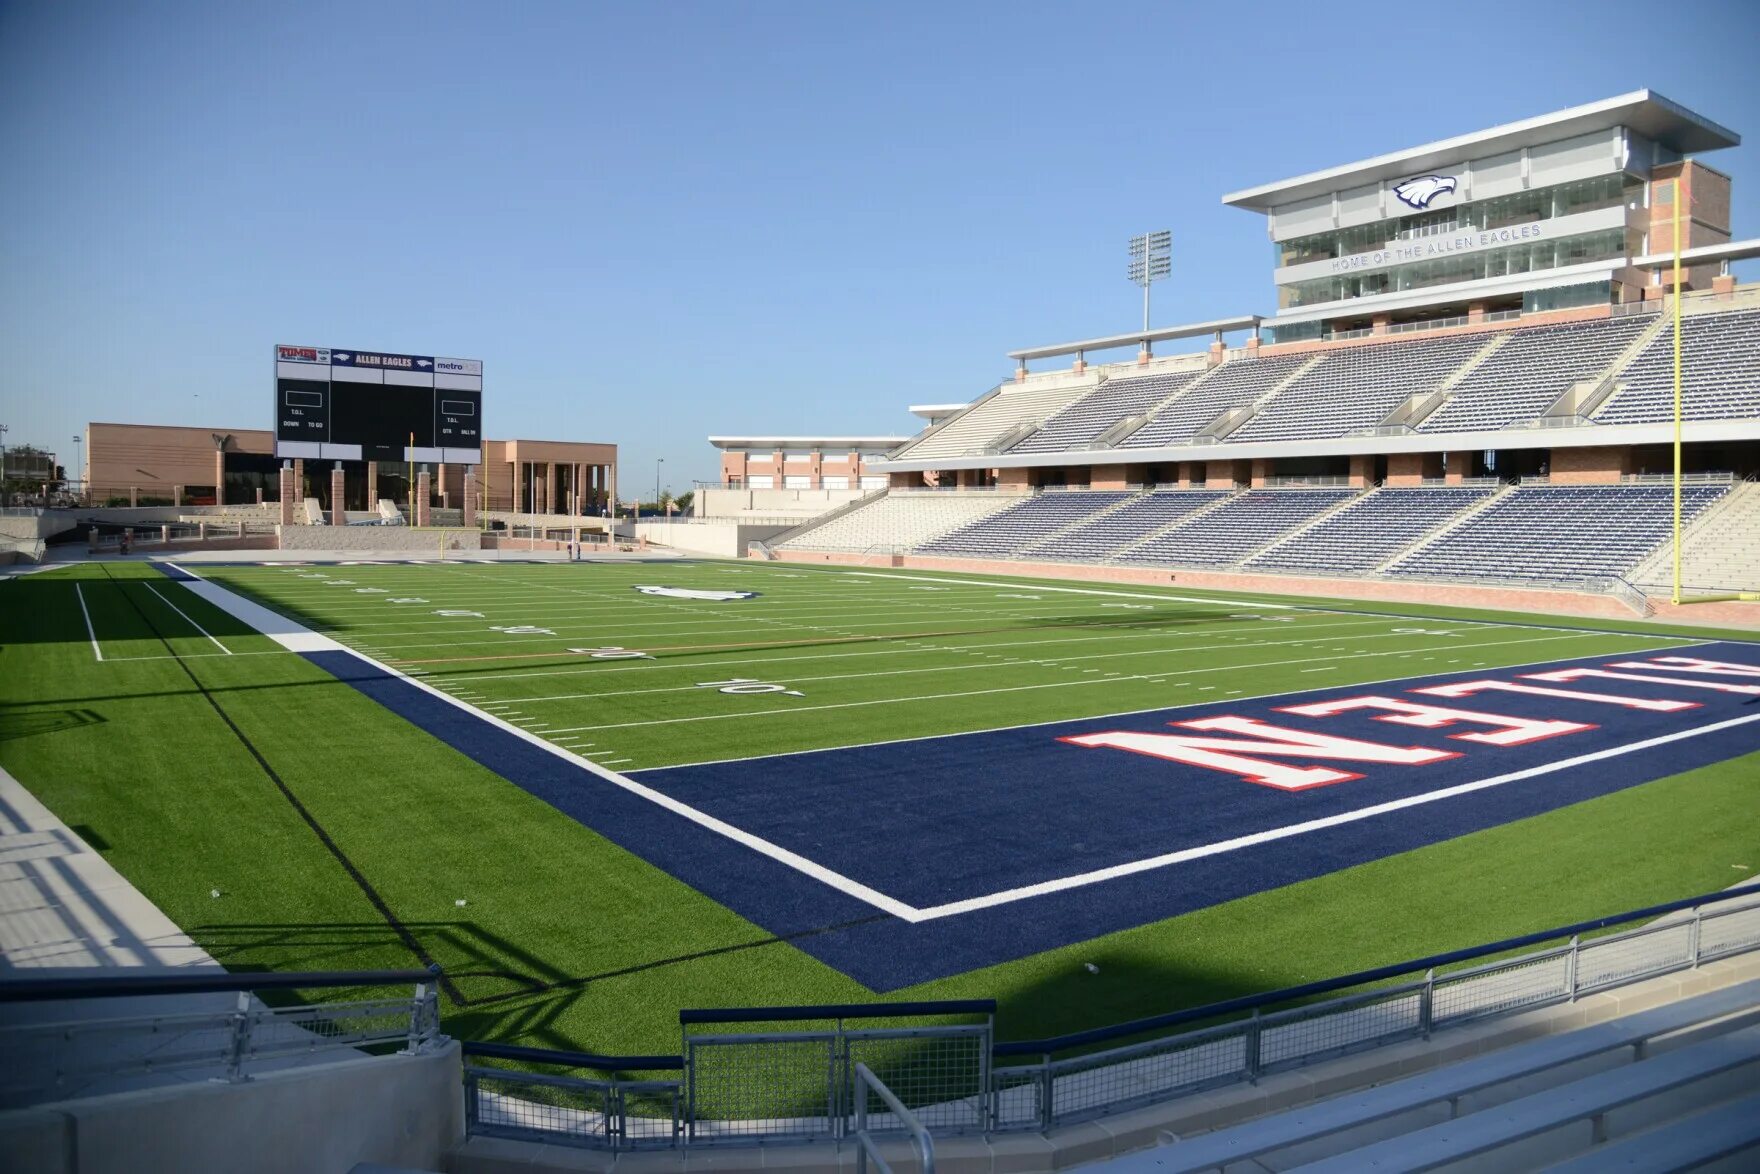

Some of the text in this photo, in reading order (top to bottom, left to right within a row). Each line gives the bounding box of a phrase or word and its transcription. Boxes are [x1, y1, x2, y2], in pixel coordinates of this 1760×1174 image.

[1331, 224, 1541, 272] HOME OF THE ALLEN EAGLES
[355, 354, 412, 368] ALLEN EAGLES
[437, 362, 463, 370] metro
[695, 678, 787, 694] 10
